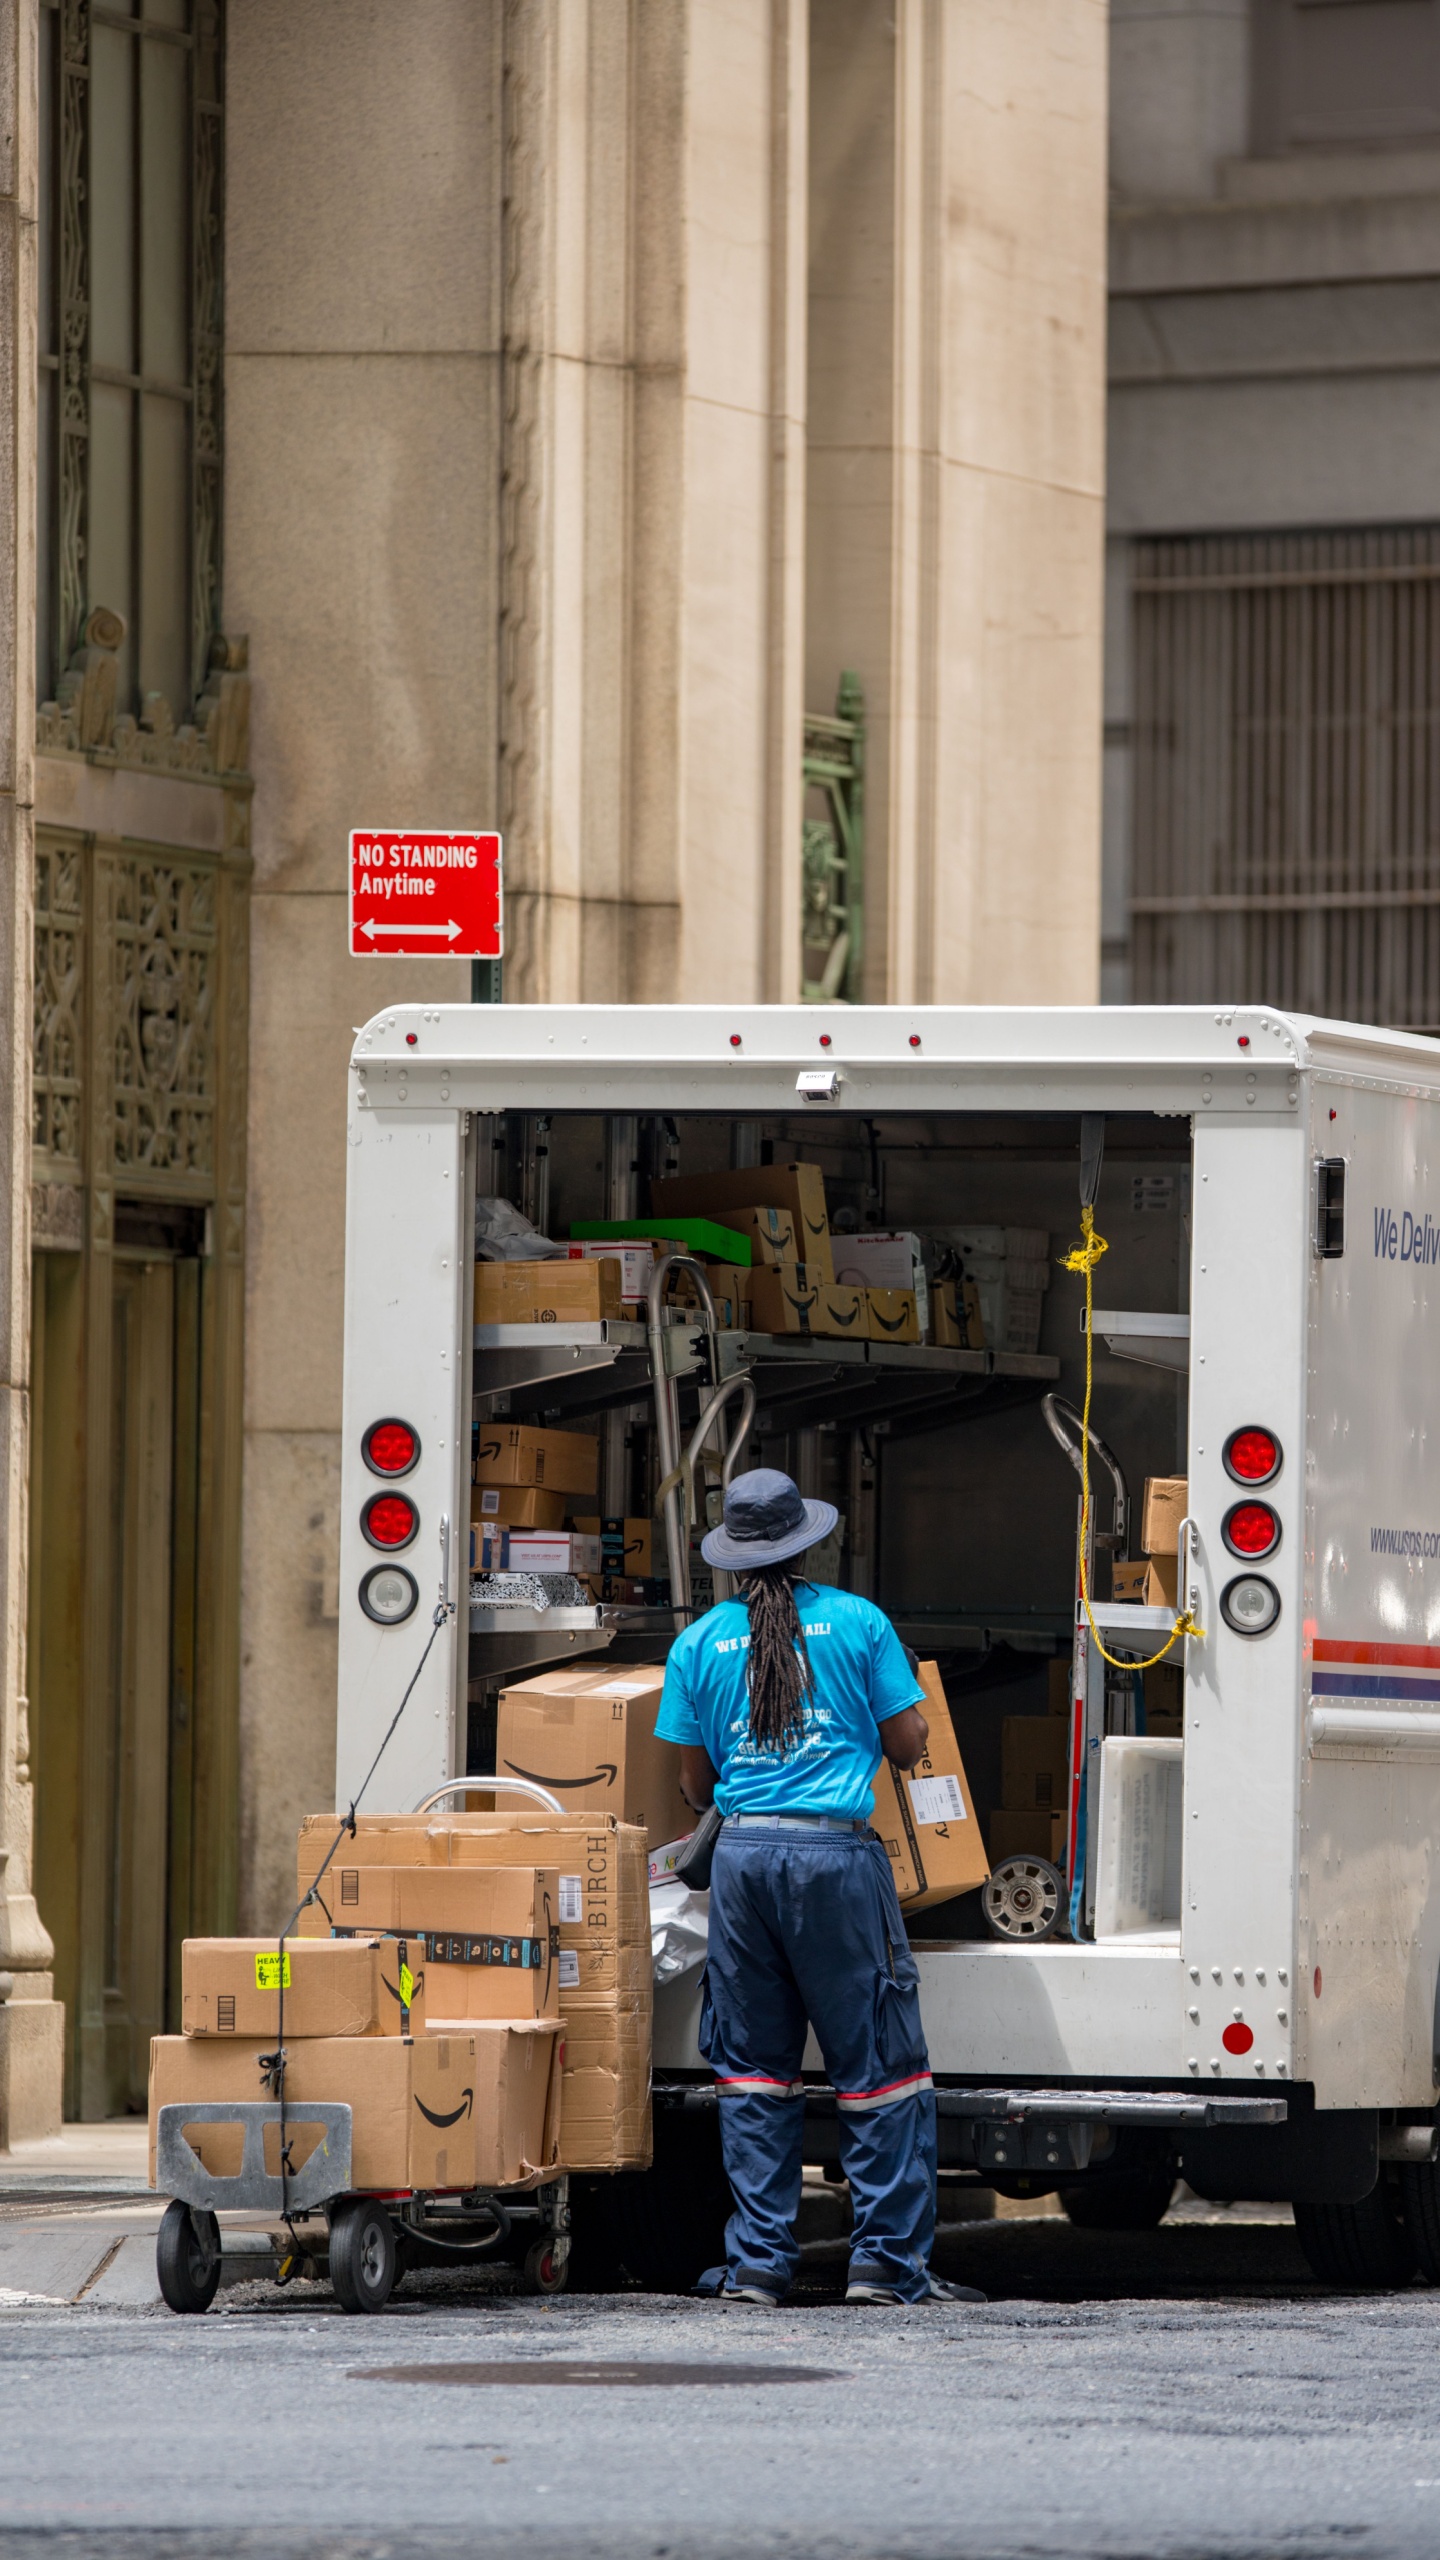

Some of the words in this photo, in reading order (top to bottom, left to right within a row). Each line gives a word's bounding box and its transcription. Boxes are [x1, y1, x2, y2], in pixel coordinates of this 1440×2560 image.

[359, 845, 385, 867] NO
[389, 846, 478, 868] STANDING
[359, 872, 436, 900] Anytime
[1374, 1207, 1398, 1259] We
[1400, 1211, 1440, 1265] Deliv
[715, 1638, 738, 1653] WE
[803, 1732, 822, 1747] 36
[896, 1782, 906, 1812] CLEANING
[901, 1809, 912, 1836] SUPPLIES
[910, 1840, 921, 1870] SANDWICH
[917, 1868, 925, 1884] BAGS
[588, 1835, 607, 1928] BIRCH
